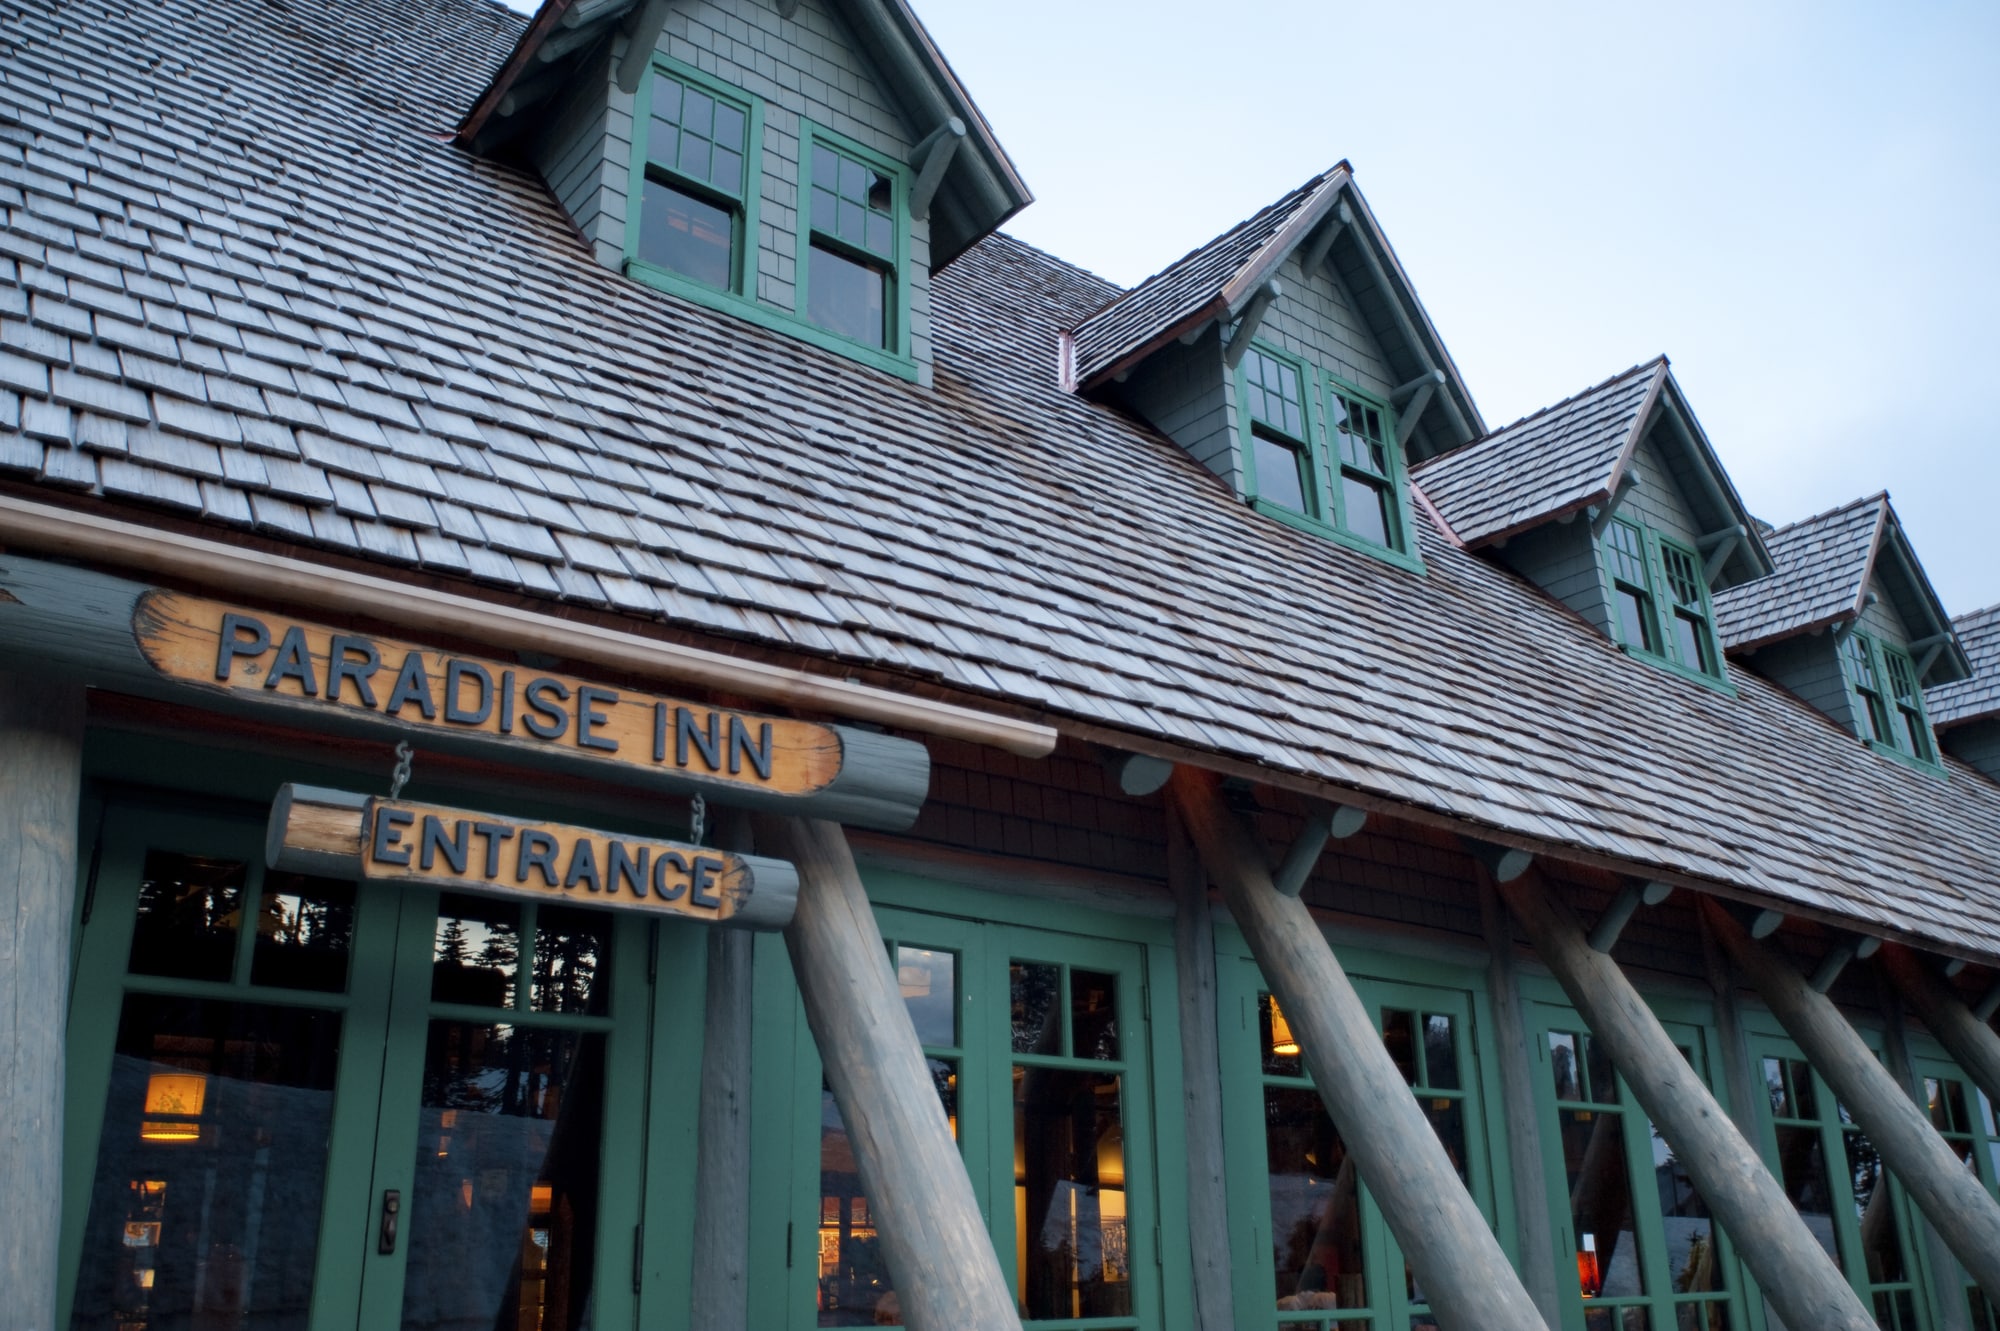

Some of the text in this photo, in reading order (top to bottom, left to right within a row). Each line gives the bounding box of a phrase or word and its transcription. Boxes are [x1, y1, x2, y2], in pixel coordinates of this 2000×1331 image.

[215, 613, 772, 780] PARADISE INN
[374, 806, 724, 909] ENTRANCE
